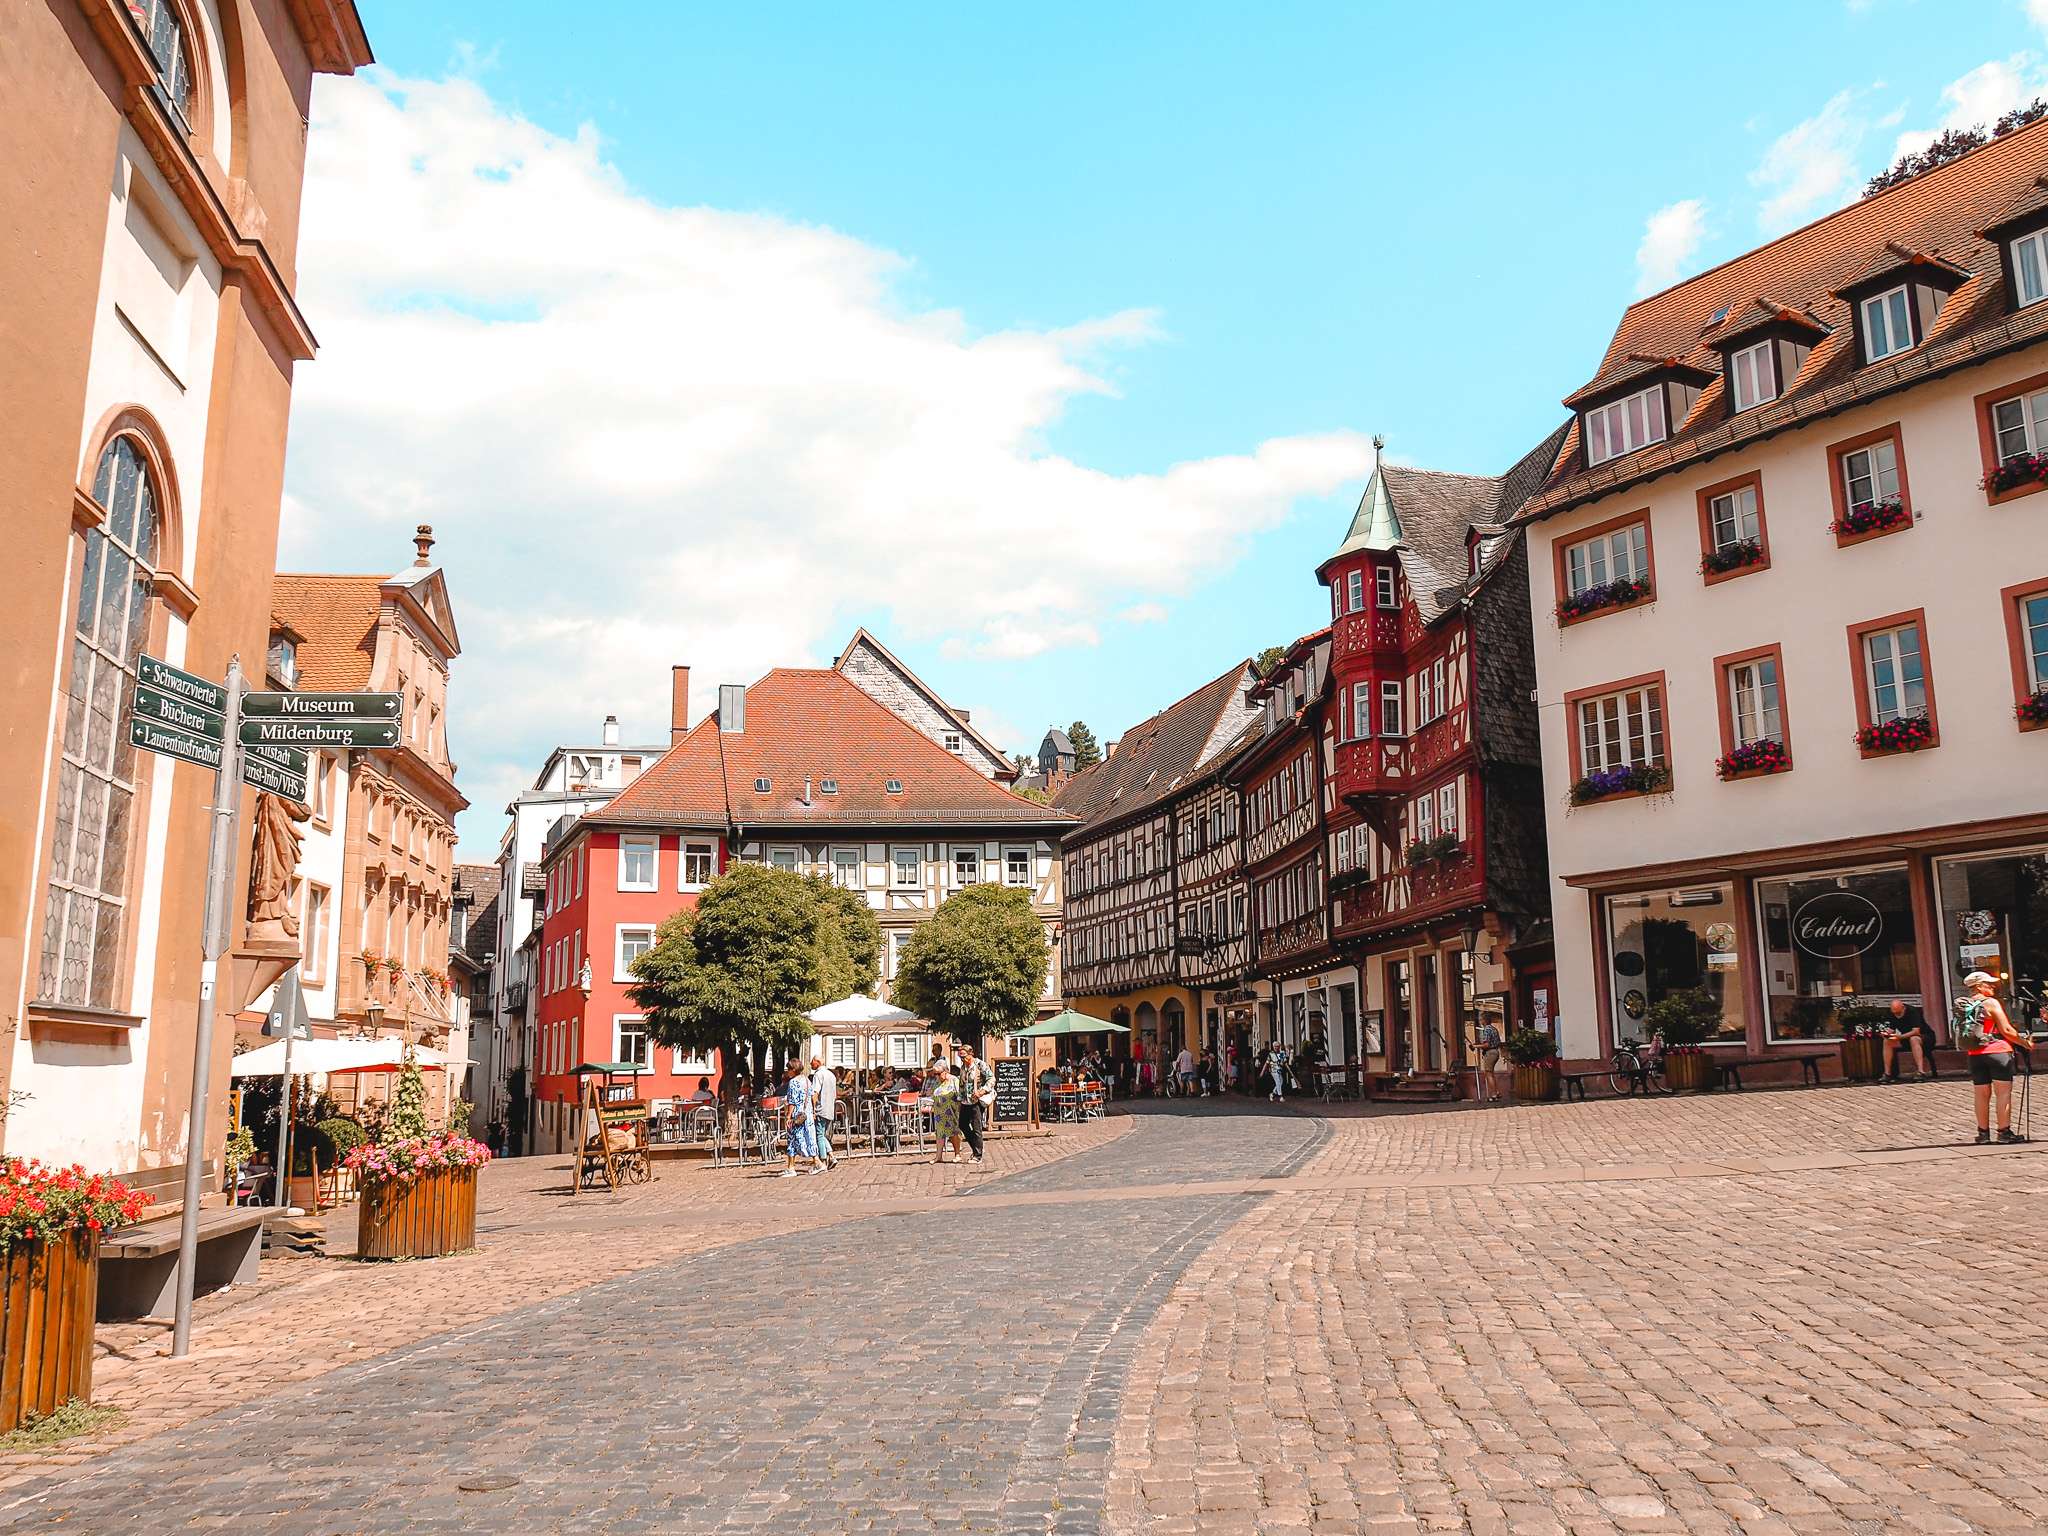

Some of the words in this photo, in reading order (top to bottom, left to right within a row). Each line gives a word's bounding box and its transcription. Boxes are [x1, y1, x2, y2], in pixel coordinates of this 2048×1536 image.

[153, 664, 217, 706] Schwarzviertel
[160, 698, 206, 731] Bücherei
[280, 696, 355, 713] Museum
[143, 725, 222, 765] Laurentiusfriedhof
[260, 725, 354, 745] Mildenburg
[1799, 915, 1876, 939] Cabinet
